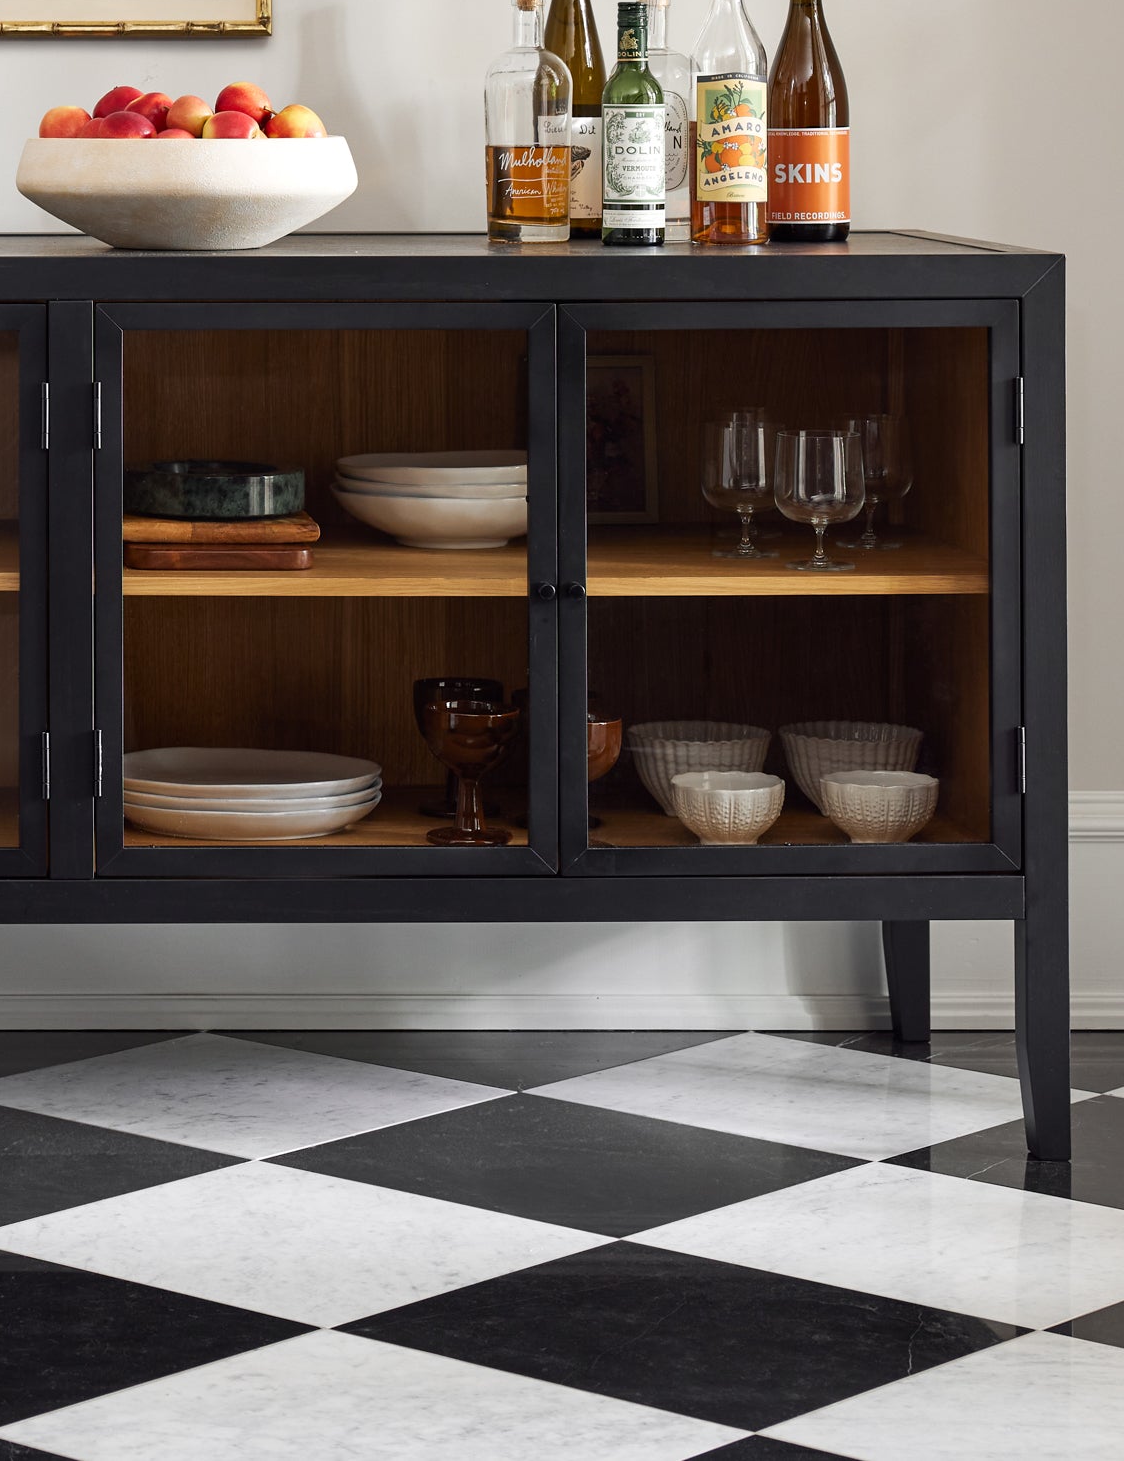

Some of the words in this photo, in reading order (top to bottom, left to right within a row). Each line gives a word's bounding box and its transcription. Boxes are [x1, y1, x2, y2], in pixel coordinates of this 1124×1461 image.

[579, 124, 597, 135] Dit
[711, 122, 761, 138] AMARO
[498, 146, 568, 170] Mulholland
[615, 146, 661, 155] DOLIN
[704, 171, 763, 187] ANGELENO
[774, 162, 843, 184] SKINS
[505, 182, 542, 196] American
[772, 212, 791, 220] FIELD
